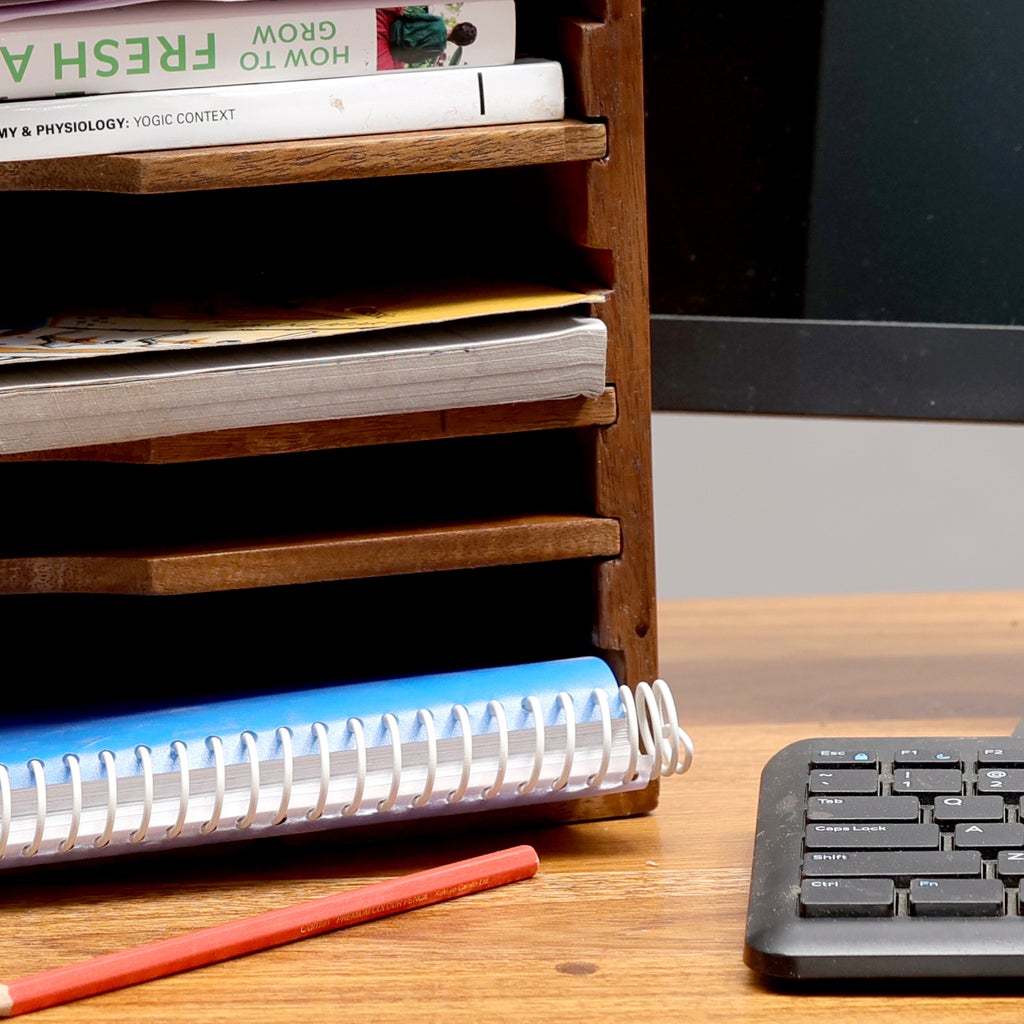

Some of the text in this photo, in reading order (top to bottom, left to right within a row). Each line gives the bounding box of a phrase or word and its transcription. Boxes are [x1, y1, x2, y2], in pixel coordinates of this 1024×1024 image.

[252, 20, 337, 45] GROW
[53, 32, 216, 80] FRESH
[239, 45, 350, 71] HOW TO
[21, 125, 32, 137] &
[36, 117, 129, 136] PHYSIOLOGY:
[133, 113, 173, 128] YOGIC
[176, 108, 236, 125] CONTEXT
[943, 798, 963, 806] Q
[964, 825, 984, 833] A
